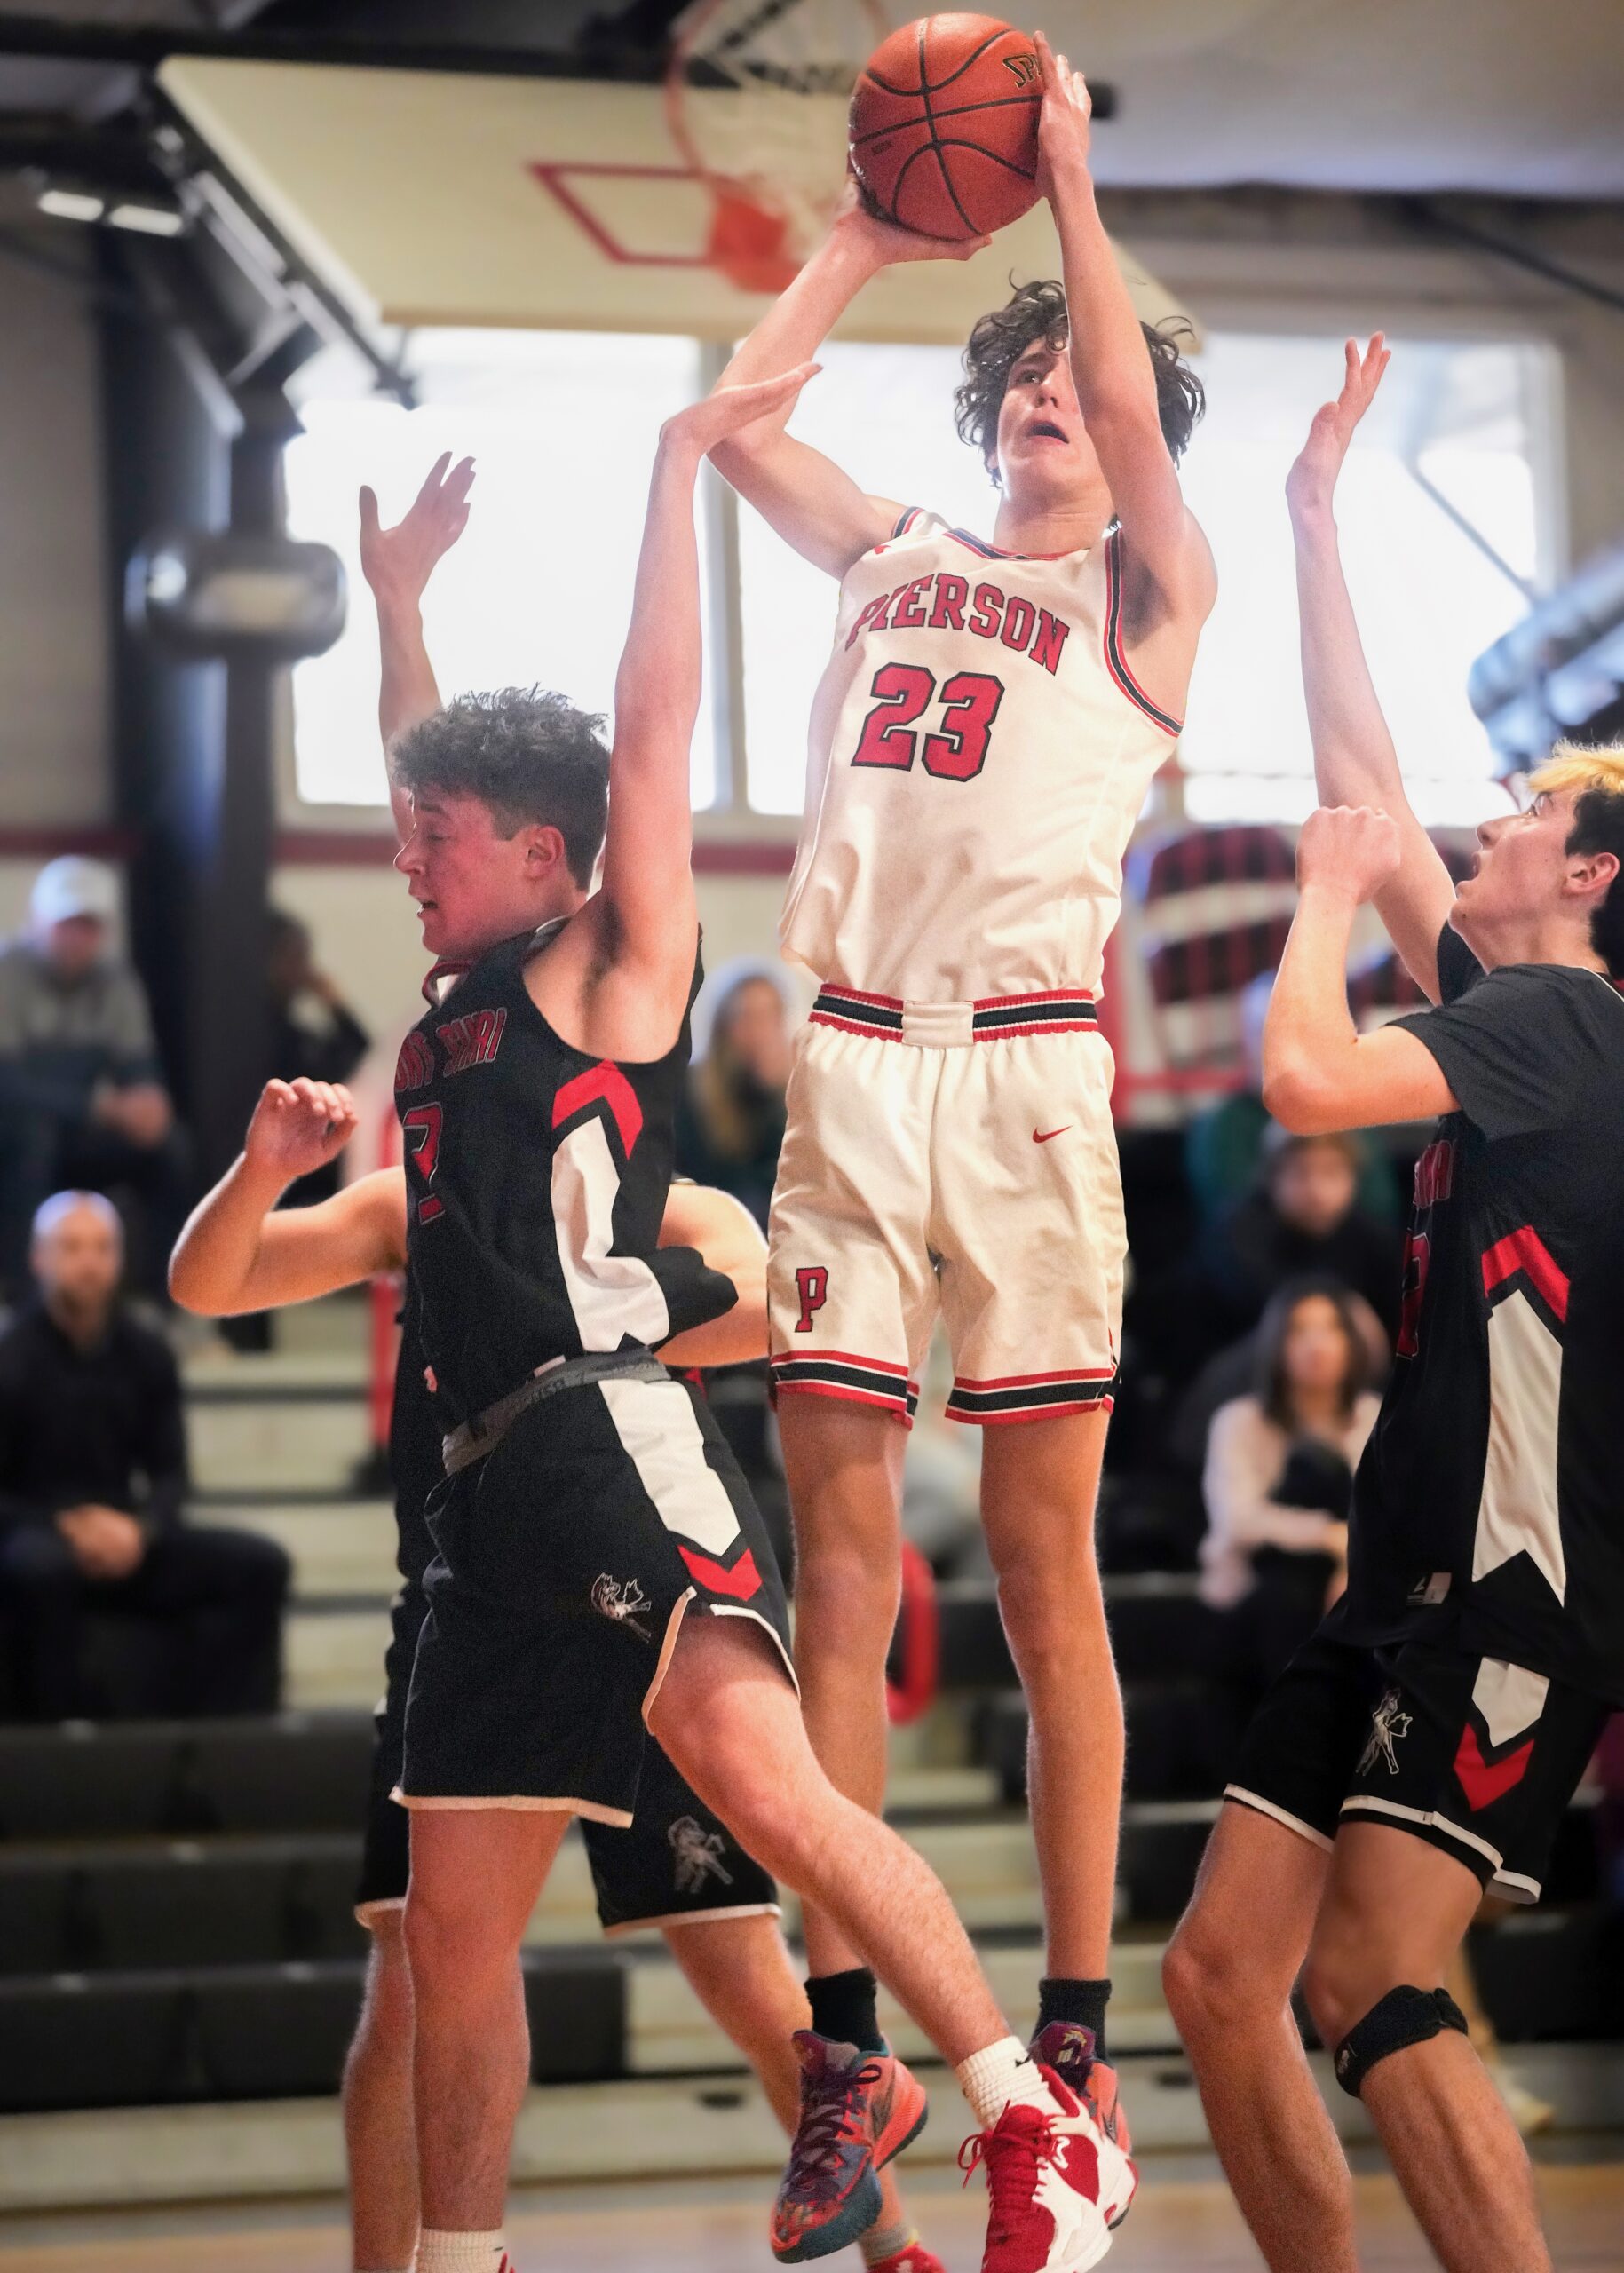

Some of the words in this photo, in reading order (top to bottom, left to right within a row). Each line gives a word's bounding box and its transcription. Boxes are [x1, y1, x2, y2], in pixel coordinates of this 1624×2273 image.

[844, 572, 1071, 677] PIERSON
[850, 661, 1006, 783] 23
[794, 1265, 829, 1333] P
